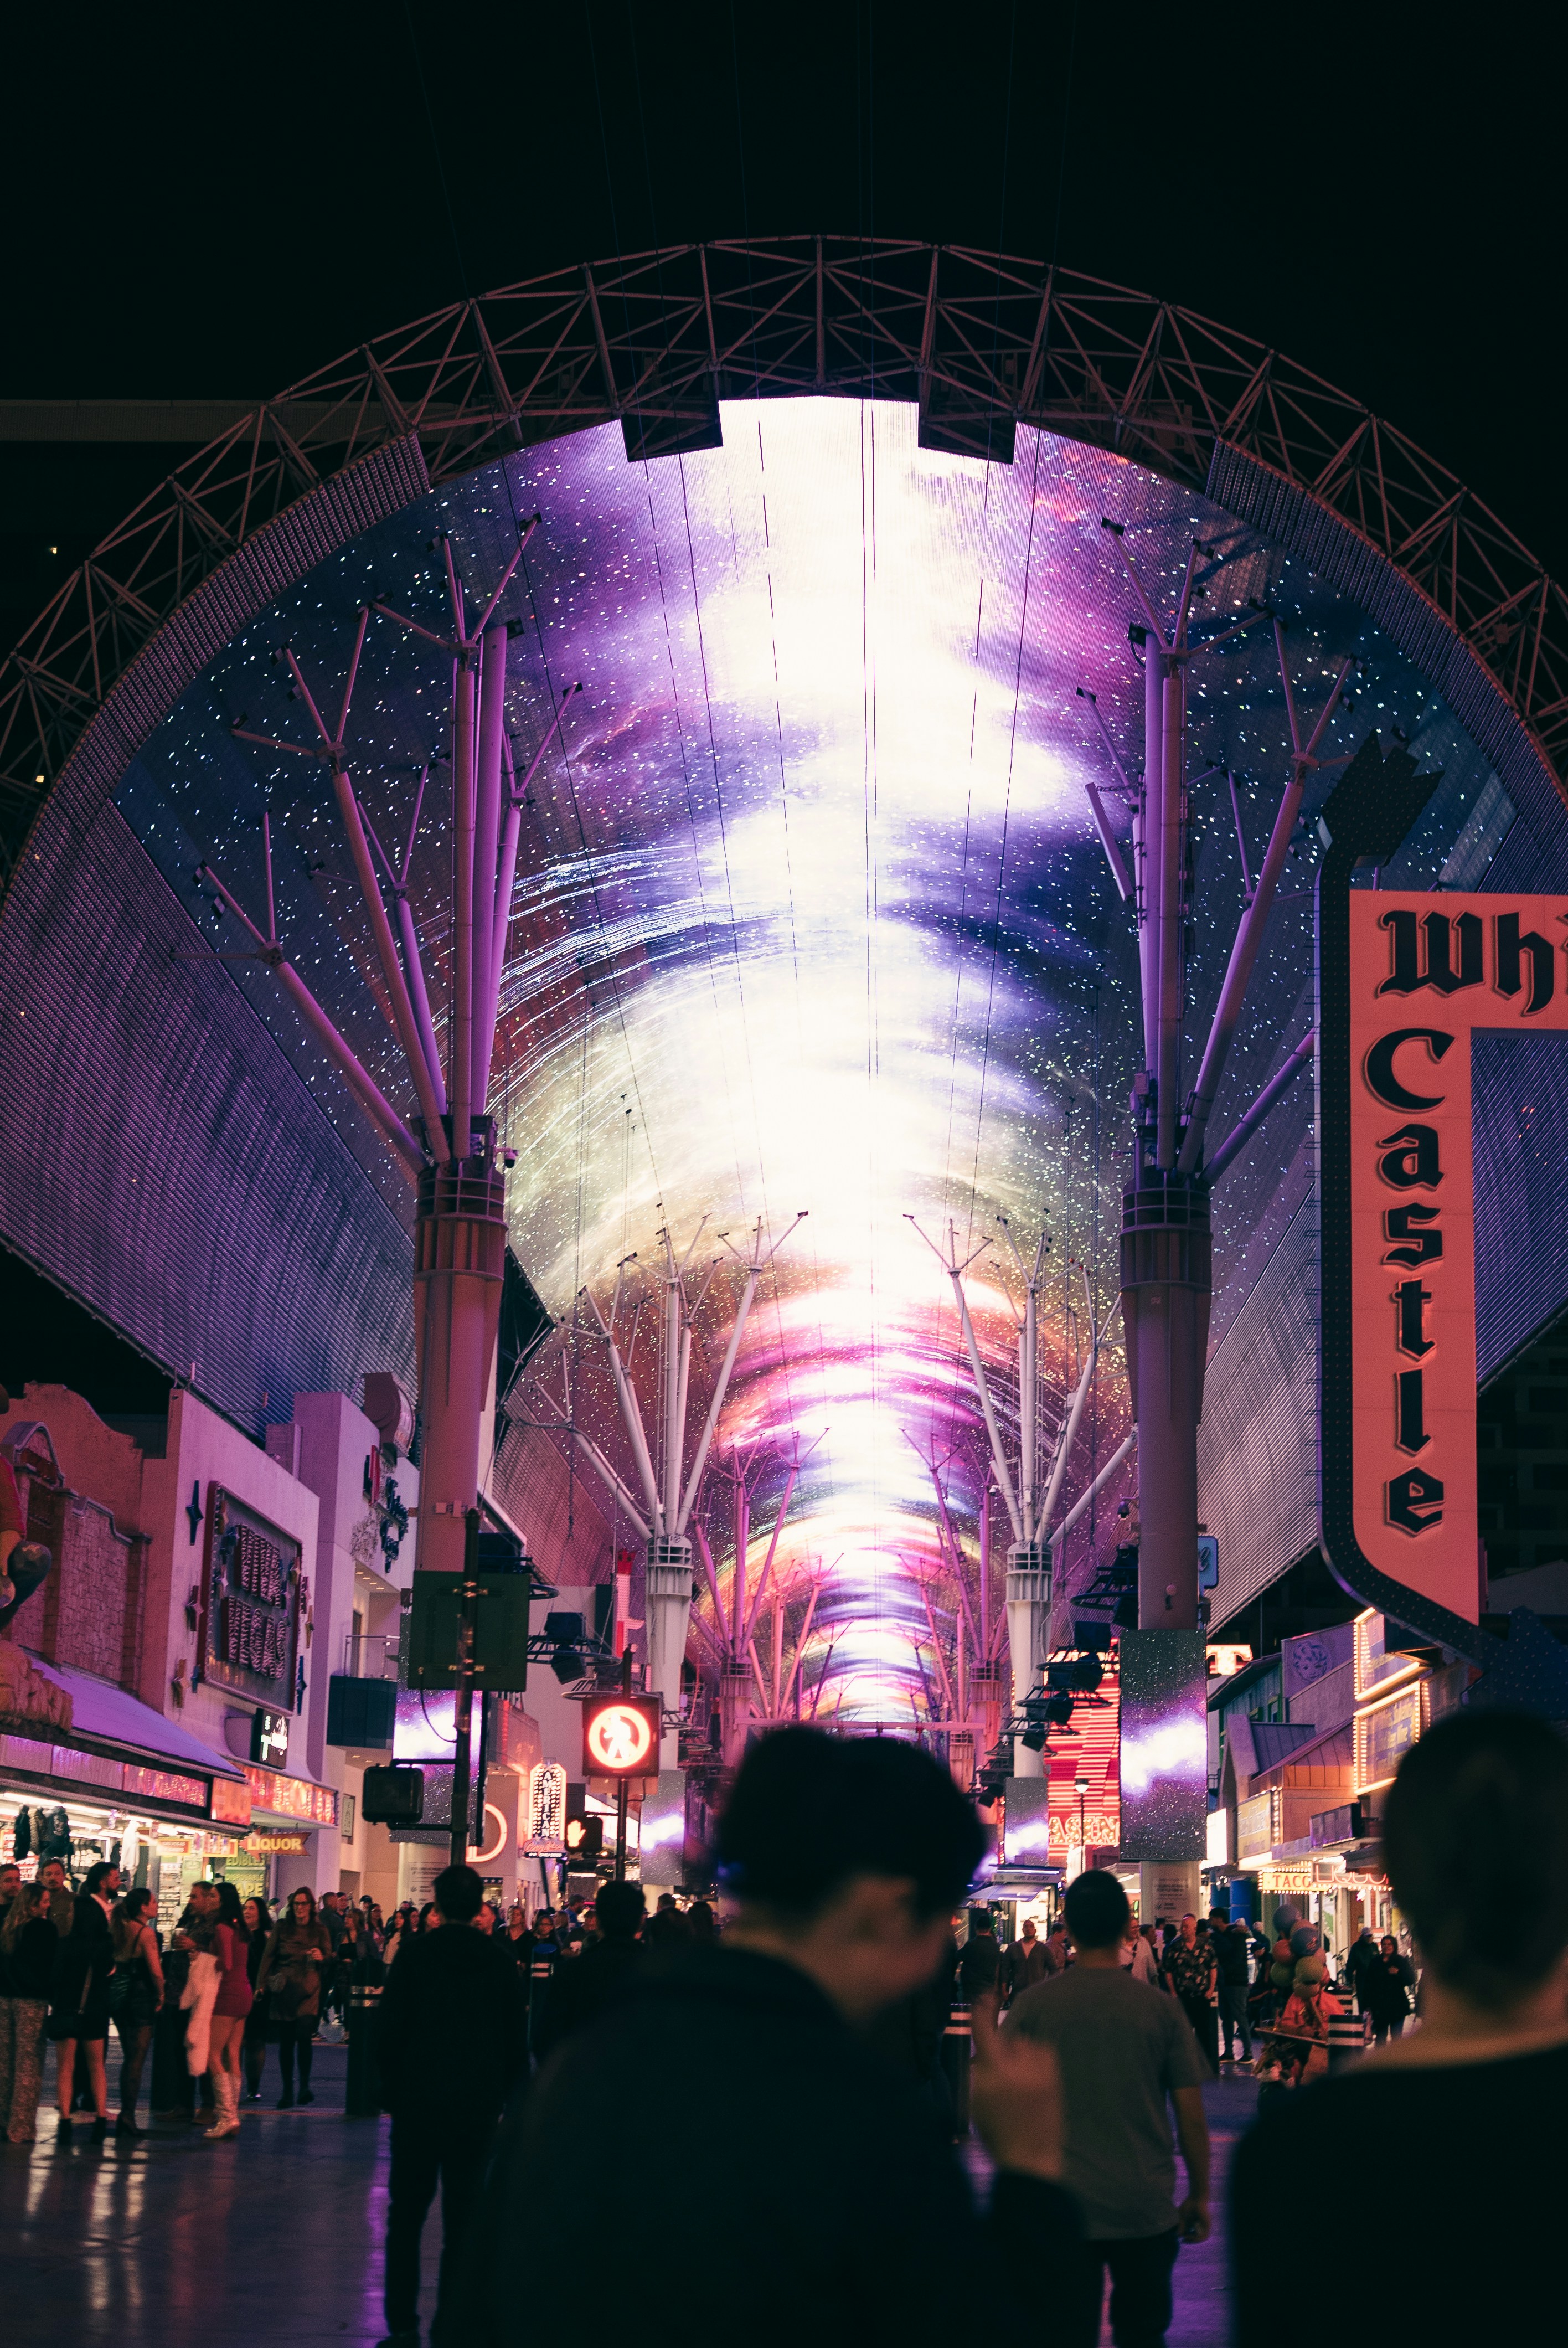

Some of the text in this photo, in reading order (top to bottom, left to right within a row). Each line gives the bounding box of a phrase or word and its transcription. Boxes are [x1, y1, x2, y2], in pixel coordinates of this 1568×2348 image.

[1363, 1028, 1456, 1536] Castle
[235, 1524, 282, 1609] VIVA
[226, 1595, 286, 1681] VEGAS
[541, 1772, 553, 1837] AMERICAN
[247, 1837, 302, 1850] LIQUOR
[233, 1882, 265, 1898] APE
